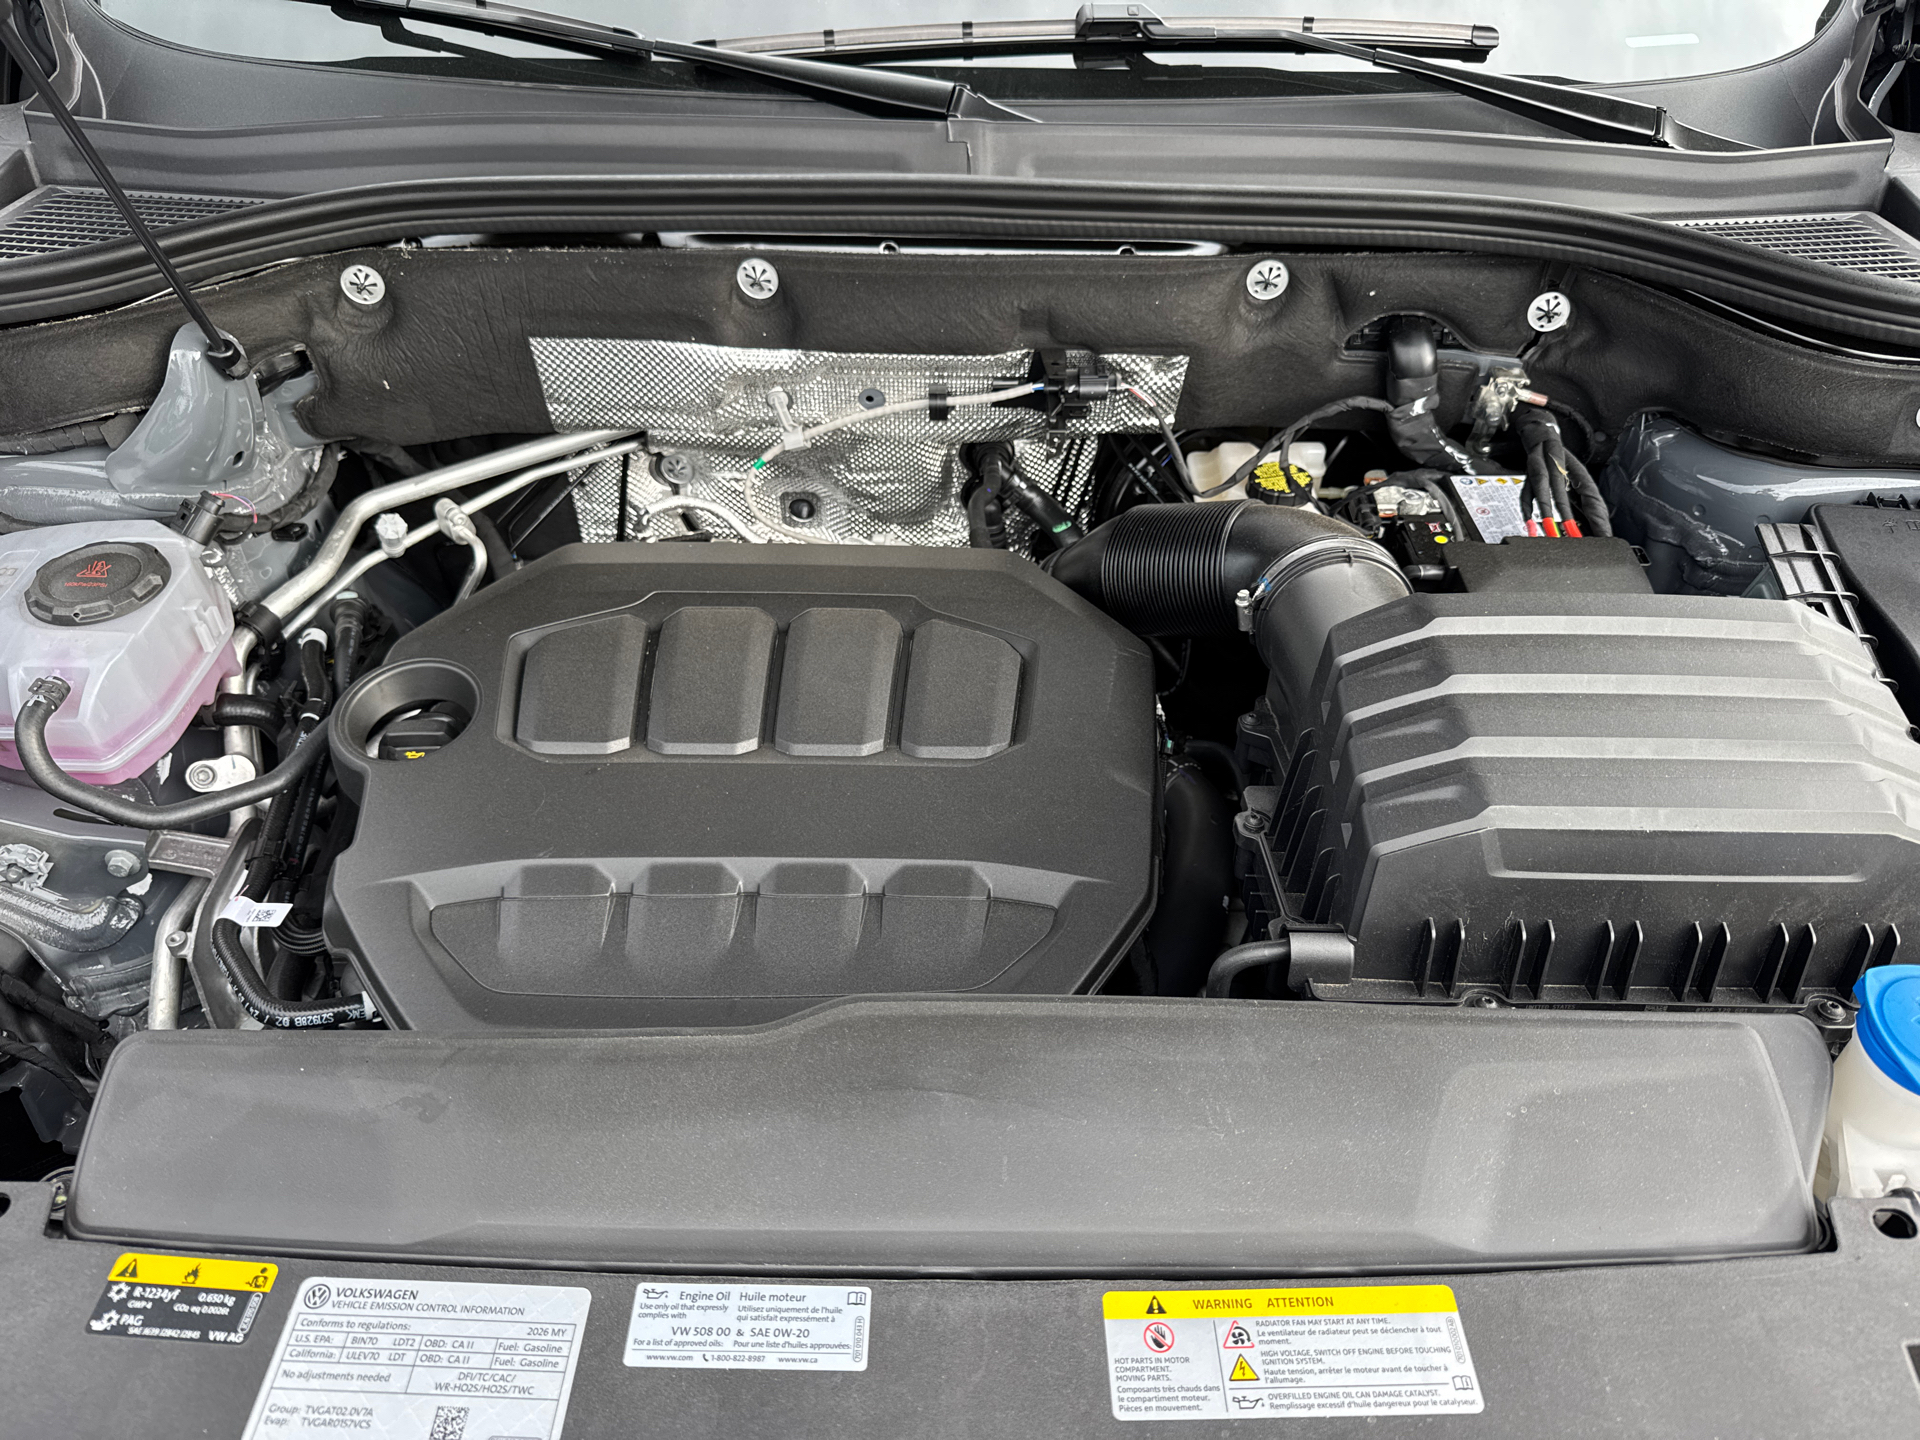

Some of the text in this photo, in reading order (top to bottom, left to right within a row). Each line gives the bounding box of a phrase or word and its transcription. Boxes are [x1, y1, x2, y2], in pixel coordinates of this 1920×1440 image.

[132, 1286, 236, 1307] R-1234yf 0.650 kg
[336, 1287, 419, 1300] VOLKSWAGEN
[679, 1291, 731, 1303] Engine Oil
[740, 1292, 807, 1302] Huile moteur
[332, 1300, 525, 1316] VEHICLE EMISSION CONTROL INFORMATION
[654, 1303, 670, 1312] only
[696, 1304, 729, 1313] expressly
[1193, 1296, 1334, 1310] WARNING ATTENTION
[638, 1312, 670, 1320] complies
[765, 1306, 809, 1315] uniquement
[119, 1314, 144, 1326] PAG
[736, 1314, 748, 1322] qui
[779, 1315, 829, 1324] expressément
[300, 1318, 567, 1337] Conforms to regulations: 2026 MY
[671, 1326, 810, 1338] VW 508 00 & SAE 0W-20
[1352, 1328, 1369, 1336] peut
[208, 1330, 227, 1342] VW
[226, 1332, 244, 1343] AG
[295, 1334, 311, 1343] U.S.
[314, 1334, 334, 1344] EPA:
[350, 1336, 378, 1346] BIN70
[392, 1338, 416, 1347] LDT2
[424, 1338, 448, 1348] OBD:
[452, 1340, 465, 1349] CA
[498, 1342, 520, 1352] Fuel:
[523, 1343, 563, 1354] Gasoline
[673, 1339, 708, 1349] approved
[809, 1341, 852, 1351] approuvées:
[289, 1348, 336, 1359] California:
[346, 1351, 380, 1361] ULEV70
[388, 1352, 406, 1362] LDT
[420, 1353, 444, 1364] OBD:
[447, 1354, 460, 1364] CA
[494, 1357, 516, 1366] Fuel:
[520, 1358, 560, 1368] Gasoline
[1279, 1350, 1312, 1358] VOLTAGE,
[281, 1369, 392, 1382] No adjustments needed
[1288, 1368, 1317, 1376] tension,
[1318, 1366, 1343, 1374] arrêter
[458, 1372, 517, 1382] DFI/TC/CAC/
[1117, 1386, 1161, 1394] Composants
[1126, 1395, 1180, 1404] compartiment
[1270, 1401, 1315, 1410] Remplissage
[1373, 1400, 1411, 1409] dangereux
[1439, 1398, 1478, 1407] catalyseur.
[268, 1403, 301, 1414] Group:
[1119, 1404, 1143, 1412] Pièces
[264, 1416, 290, 1428] Evap:
